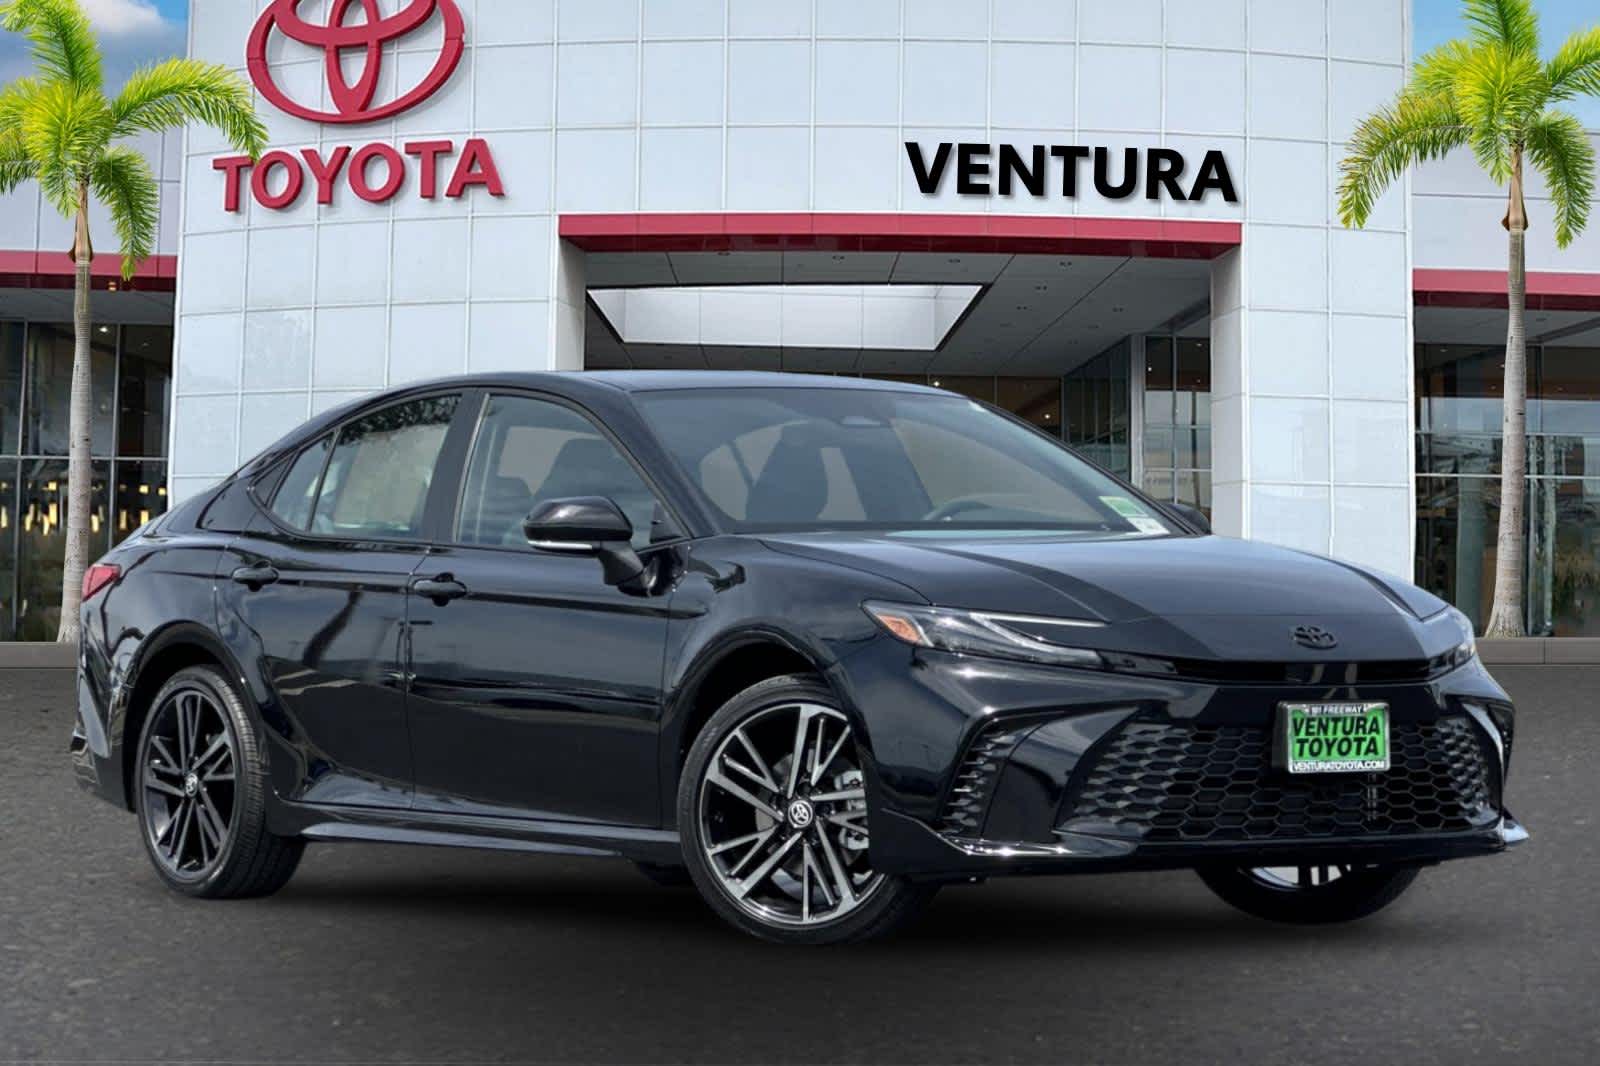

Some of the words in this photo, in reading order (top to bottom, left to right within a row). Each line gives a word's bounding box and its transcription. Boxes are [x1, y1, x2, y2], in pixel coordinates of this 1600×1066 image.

[212, 138, 505, 212] TOYOTA
[905, 141, 1238, 202] VENTURA
[1293, 716, 1380, 736] VENTURA
[1296, 737, 1379, 757] TOYOTA
[1293, 760, 1385, 771] VENTURATOYOTA.COM
